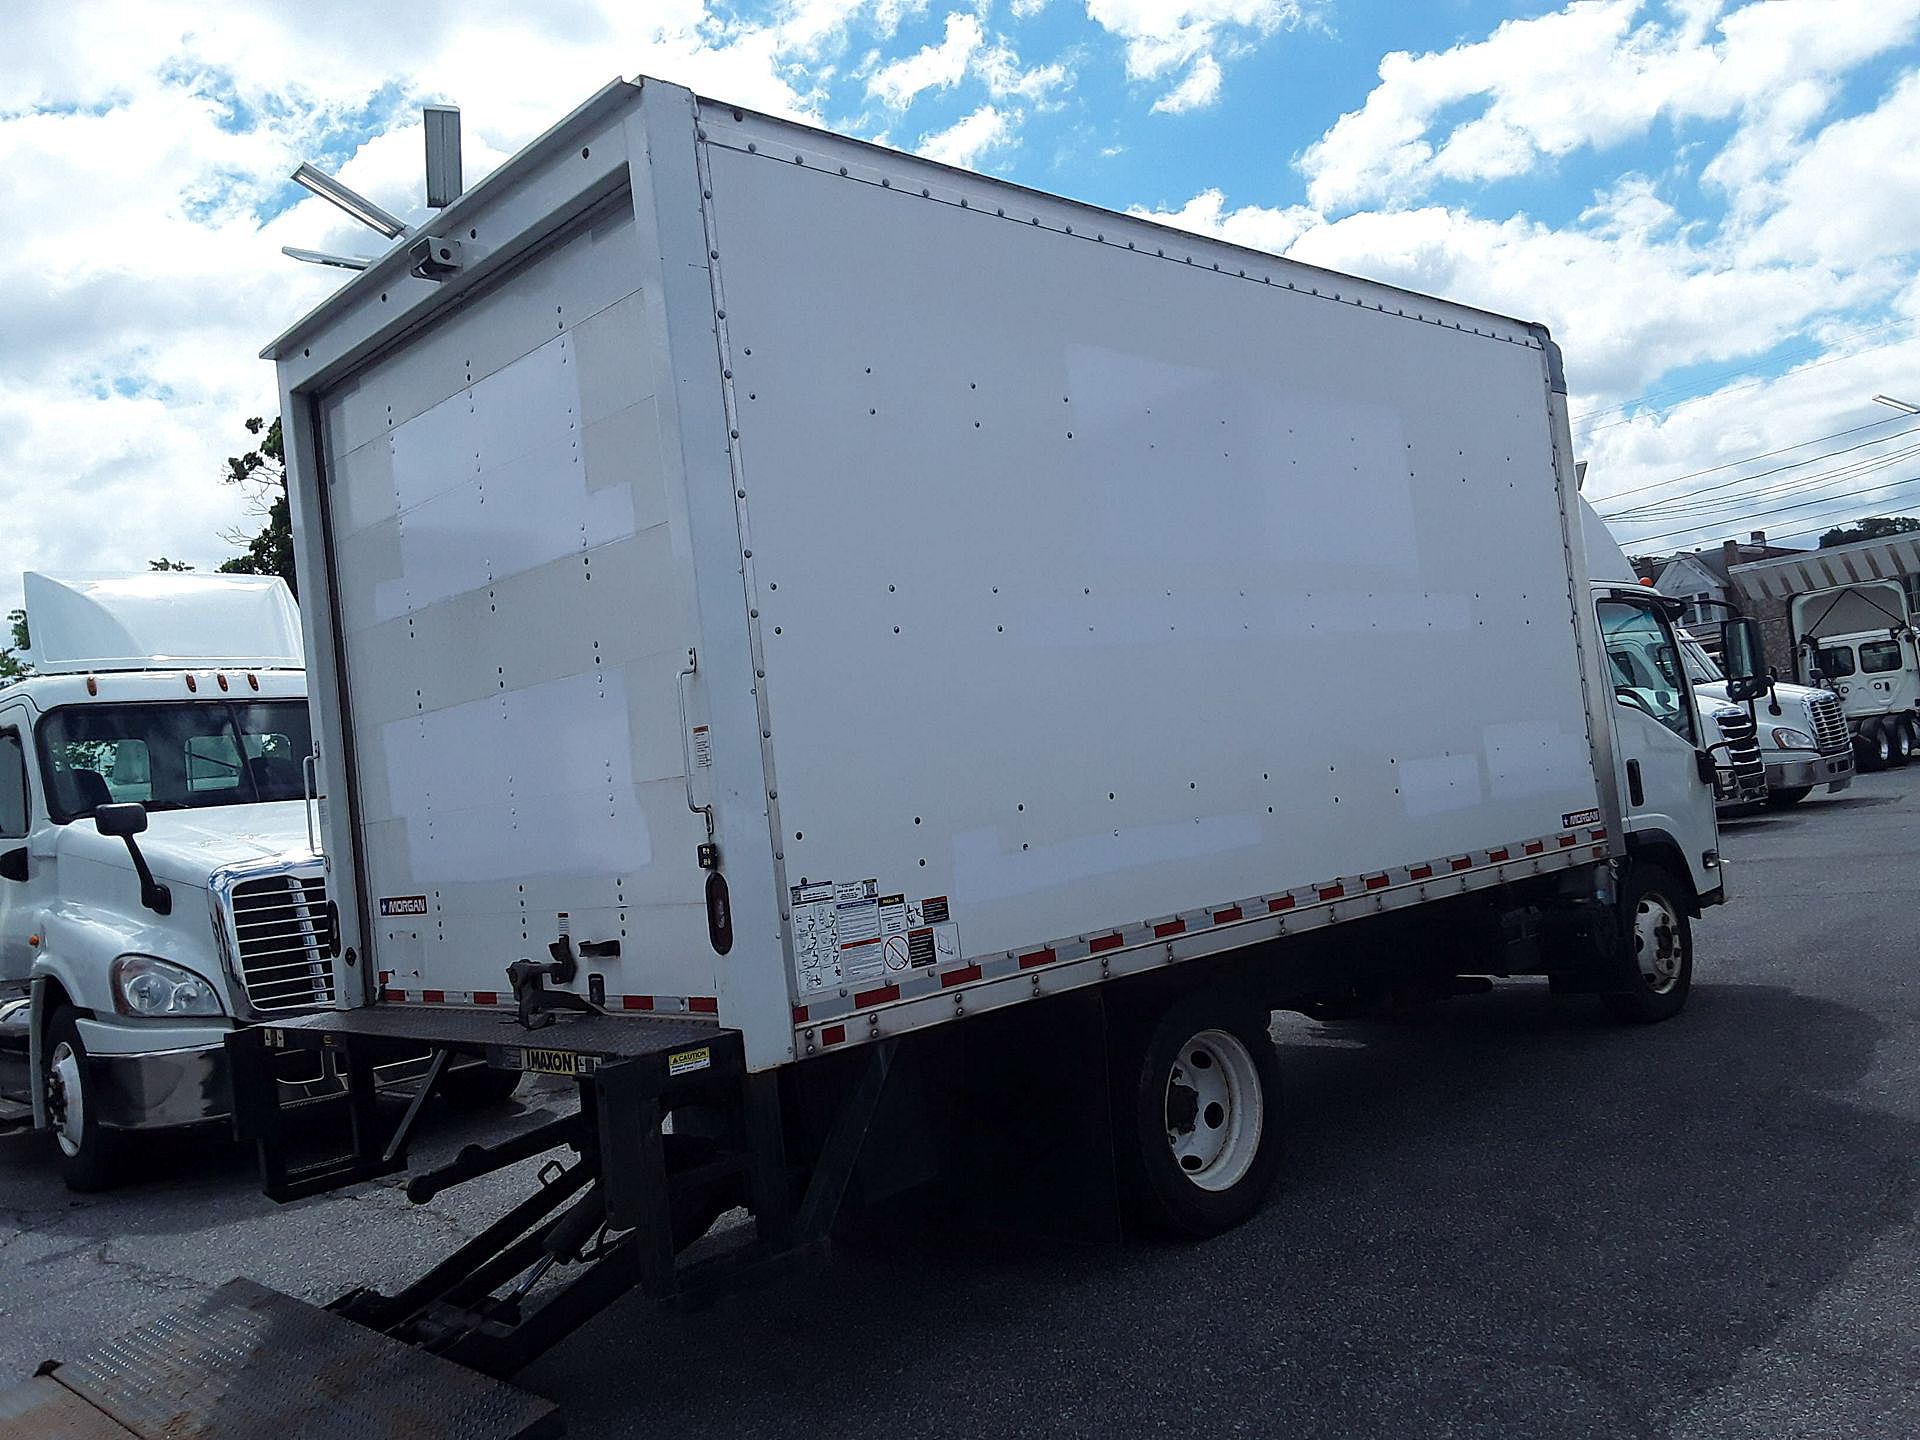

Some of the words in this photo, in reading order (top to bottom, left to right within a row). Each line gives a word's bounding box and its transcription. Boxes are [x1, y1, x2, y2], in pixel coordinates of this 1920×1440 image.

[1569, 811, 1599, 825] MORGAN
[388, 899, 425, 913] MORGAN
[531, 1050, 572, 1072] MAXON
[678, 1051, 706, 1062] CAUTION
